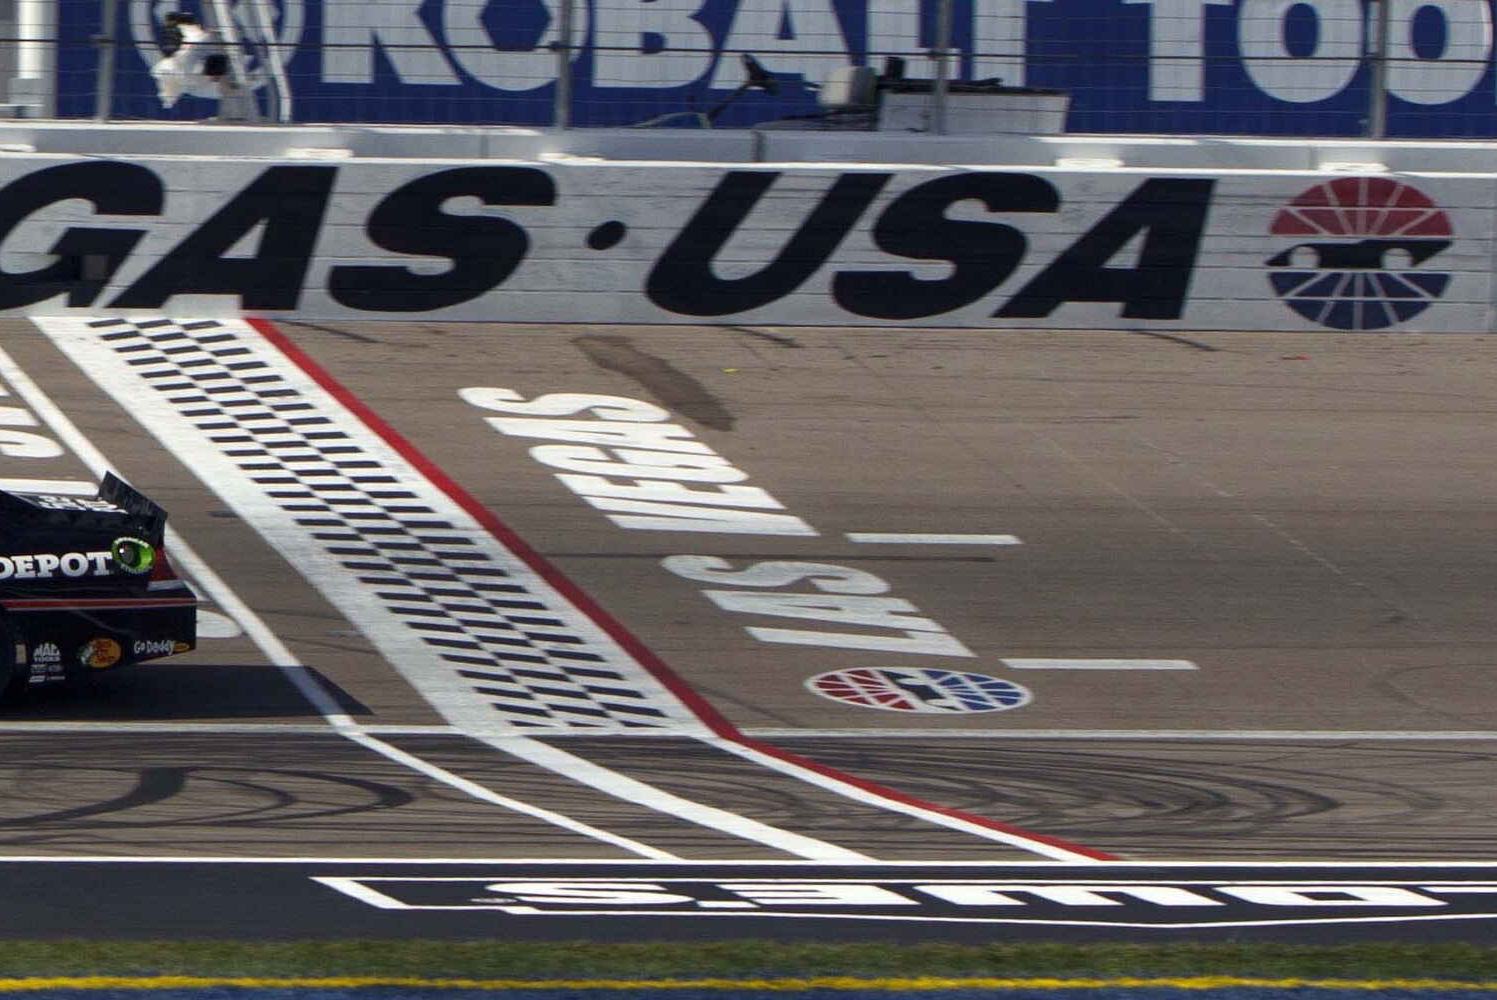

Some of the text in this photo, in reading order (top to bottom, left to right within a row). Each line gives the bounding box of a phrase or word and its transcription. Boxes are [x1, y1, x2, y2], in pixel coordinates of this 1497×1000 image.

[644, 169, 1217, 320] USA
[457, 386, 821, 537] VEGAS
[486, 880, 1497, 908] OWE'S
